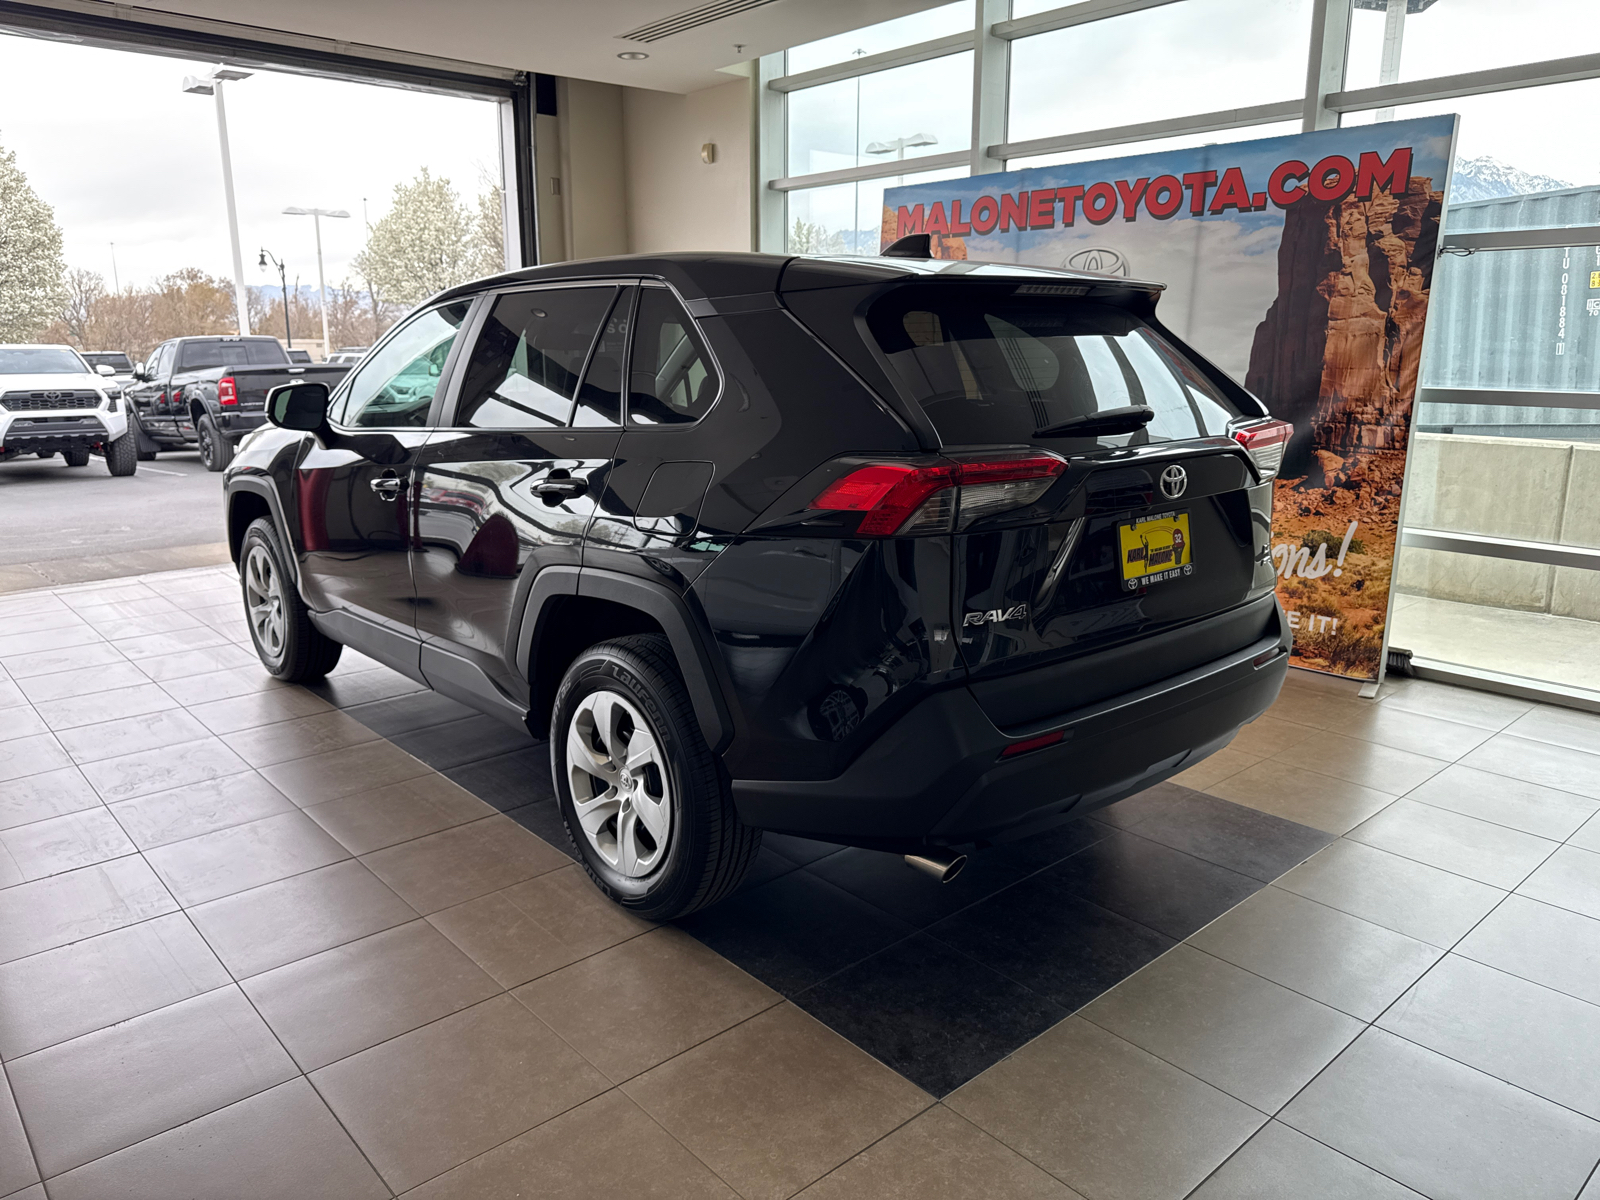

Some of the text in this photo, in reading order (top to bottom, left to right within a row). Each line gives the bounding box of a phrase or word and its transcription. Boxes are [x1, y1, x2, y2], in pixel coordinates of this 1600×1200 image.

[896, 146, 1414, 239] MALONETOYOTA.COM
[1174, 533, 1182, 544] 32
[1127, 548, 1145, 563] KARL
[1270, 521, 1358, 579] ons!
[1141, 569, 1181, 586] WE MAKE IT EASY
[963, 604, 1027, 627] RAV4
[1308, 614, 1338, 636] IT!
